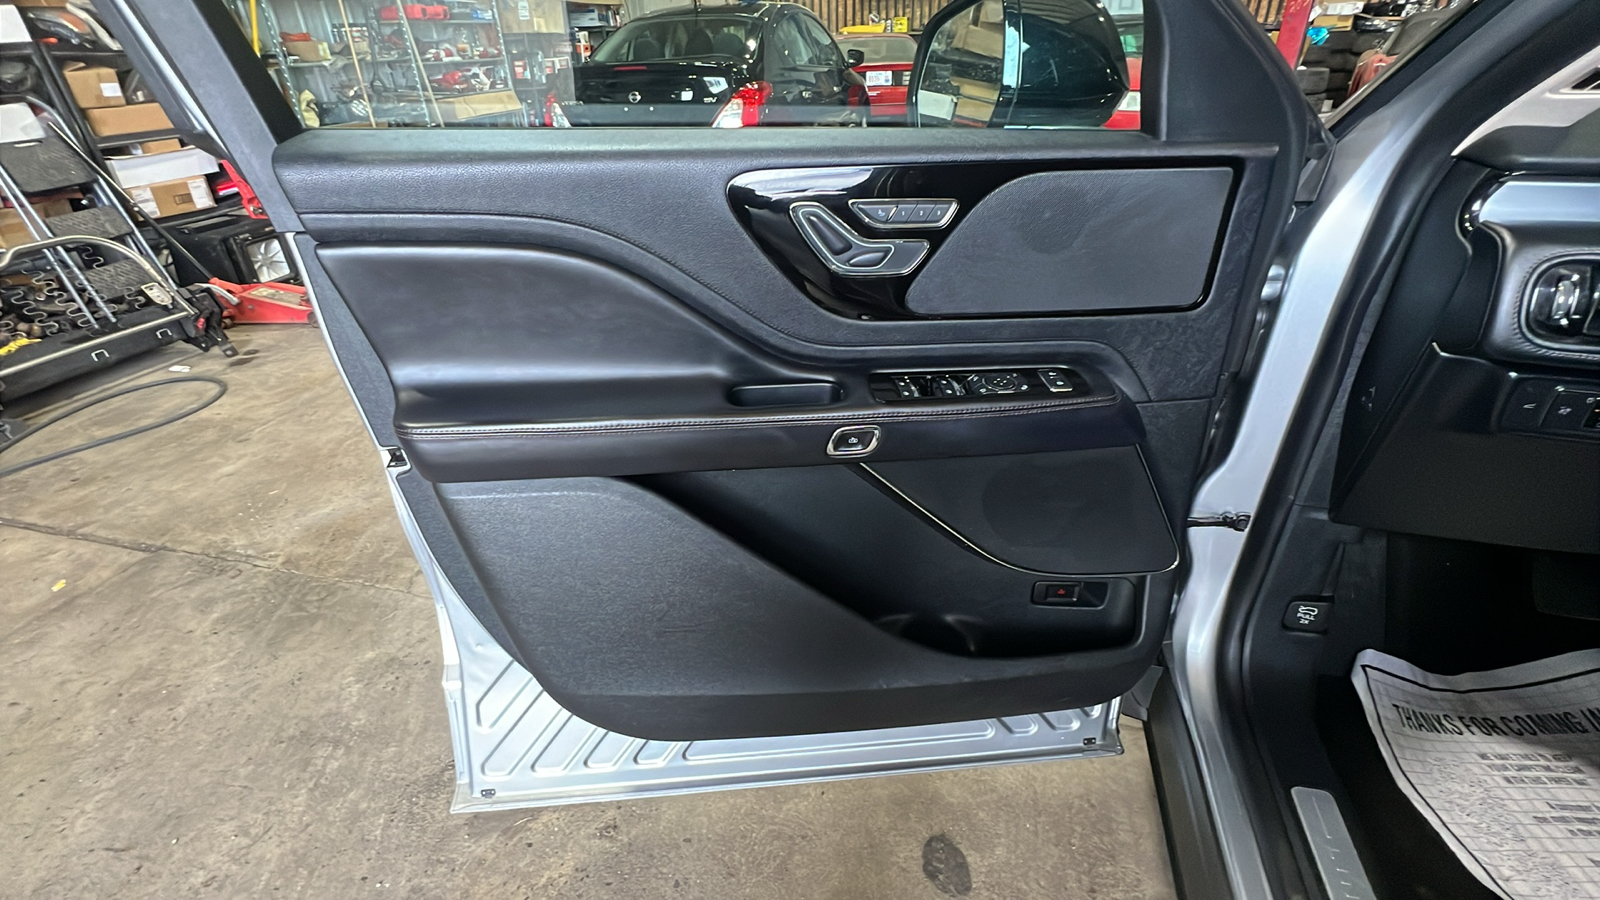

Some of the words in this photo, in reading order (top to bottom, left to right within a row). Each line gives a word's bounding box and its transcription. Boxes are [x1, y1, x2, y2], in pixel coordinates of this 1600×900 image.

[1296, 612, 1315, 621] PULL
[1391, 703, 1463, 736] THANKS
[1457, 715, 1509, 737] FOR
[1499, 711, 1590, 737] COMING
